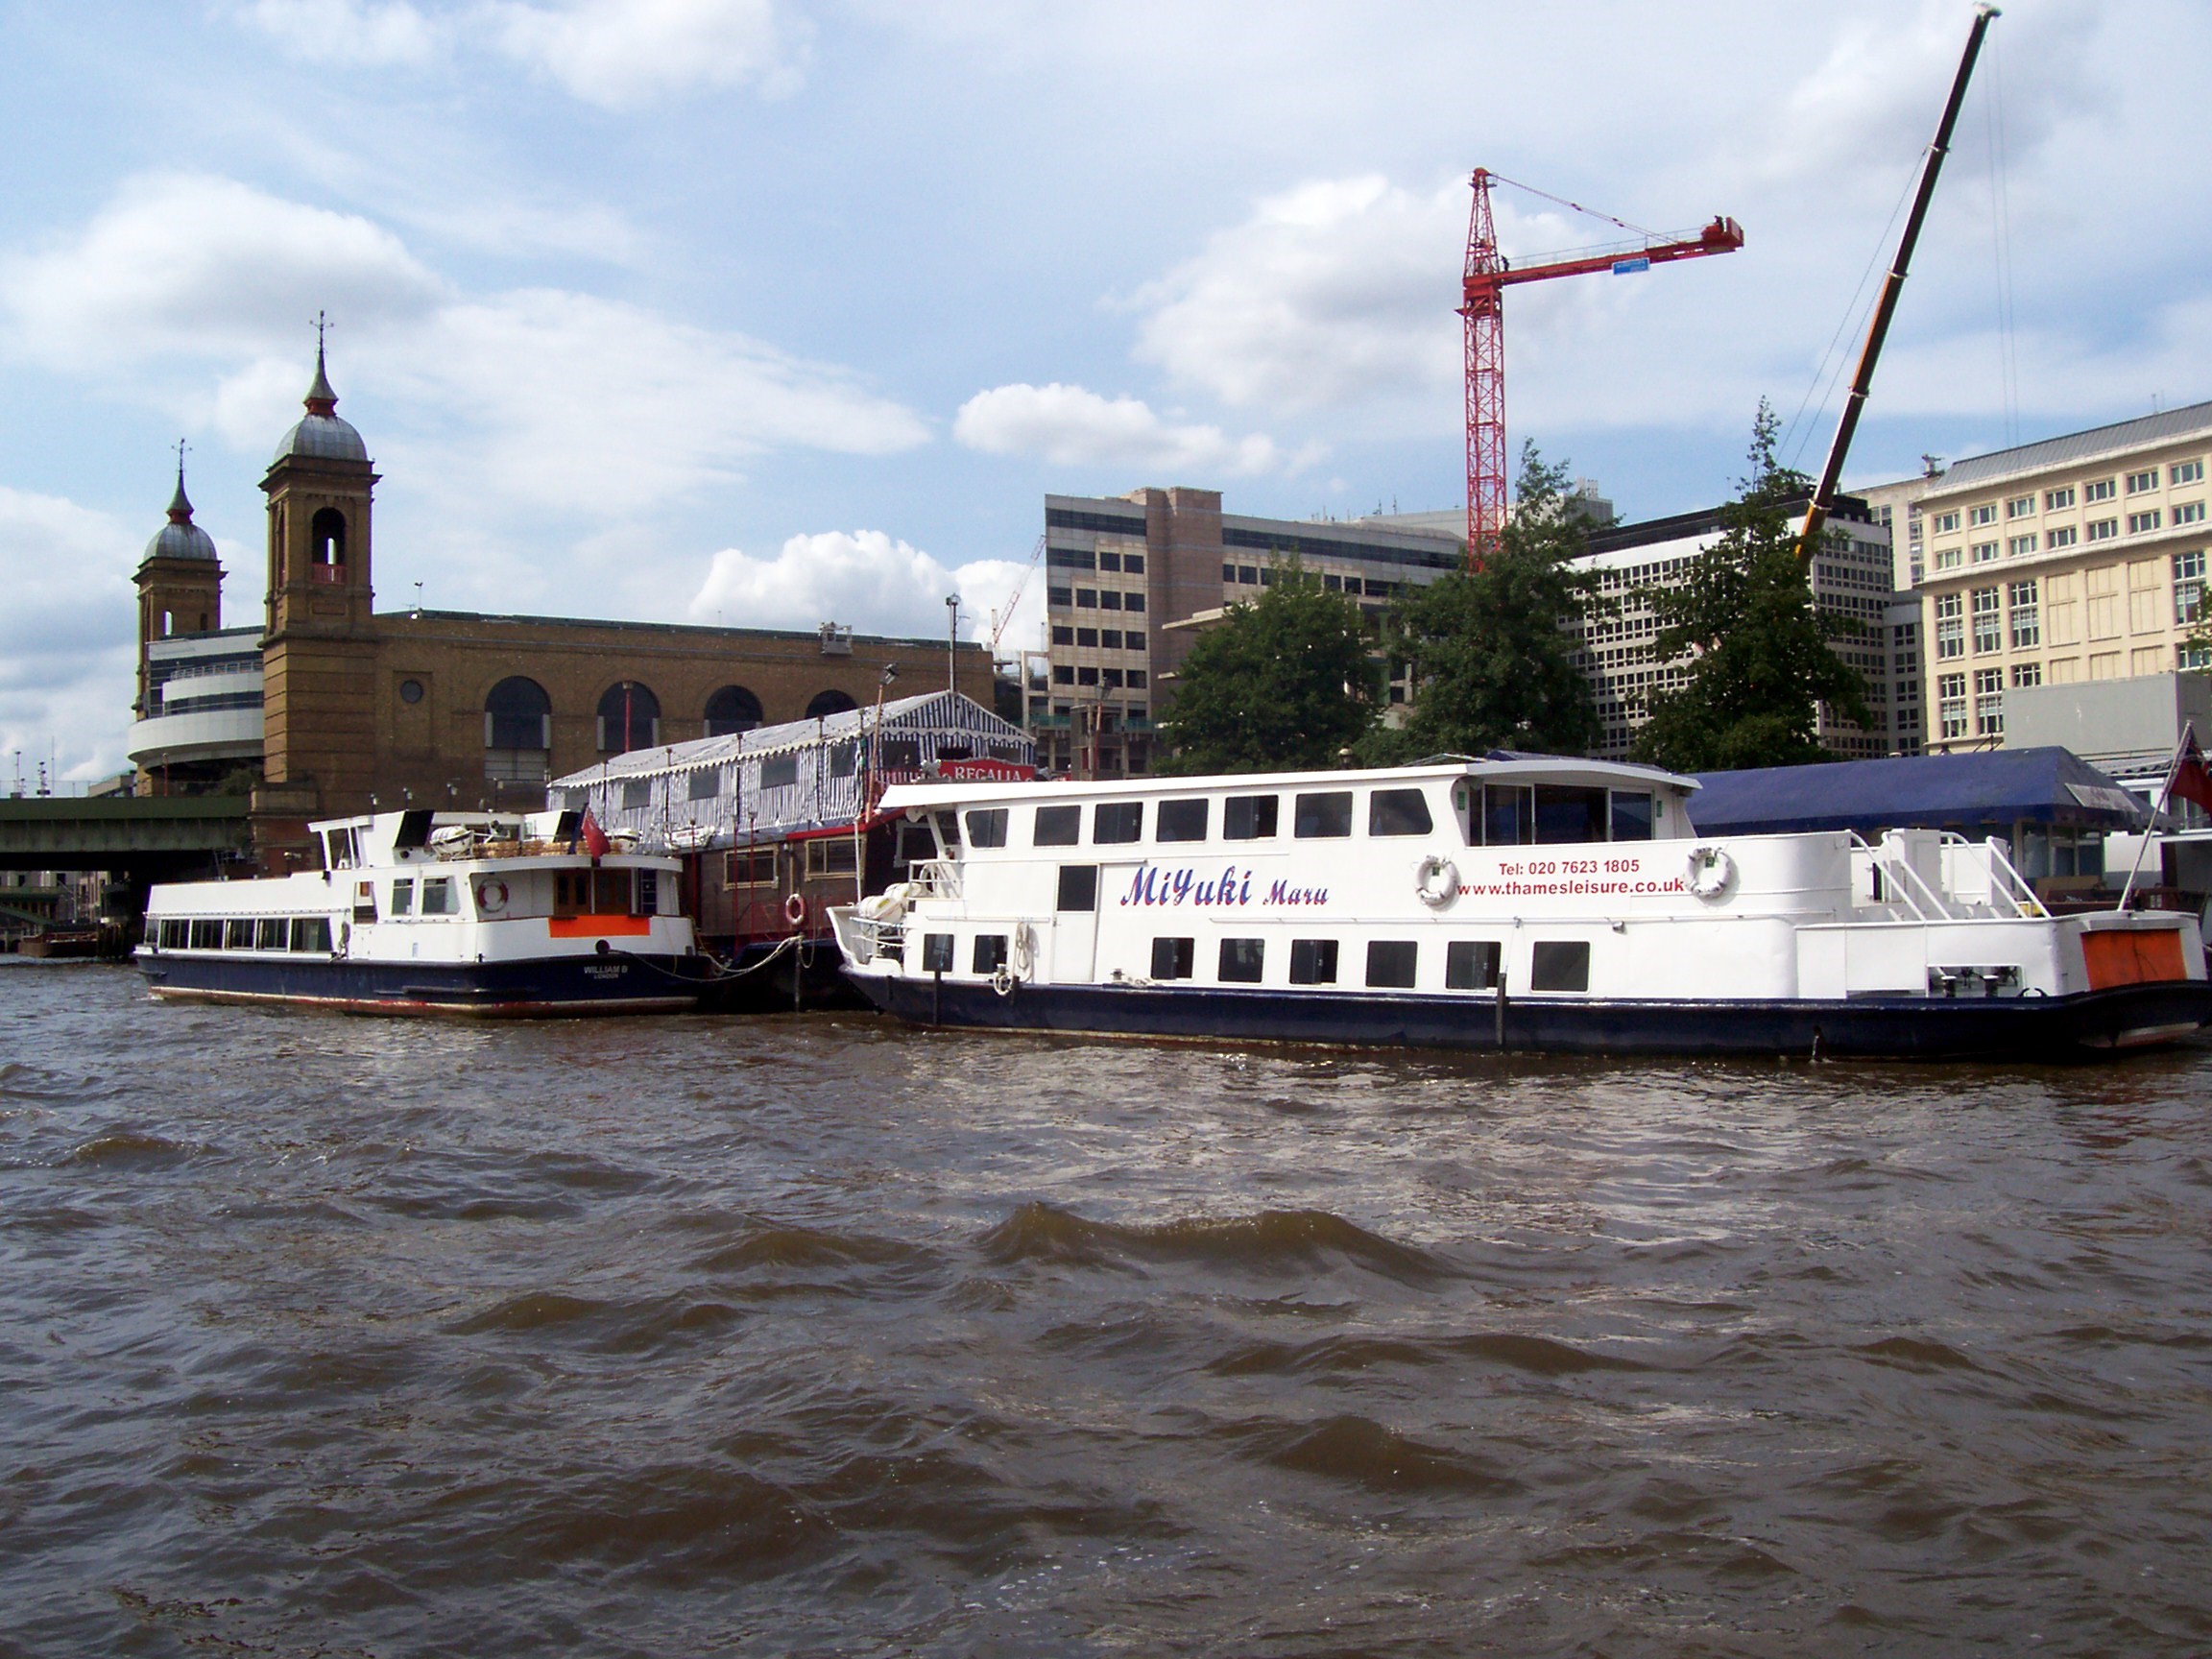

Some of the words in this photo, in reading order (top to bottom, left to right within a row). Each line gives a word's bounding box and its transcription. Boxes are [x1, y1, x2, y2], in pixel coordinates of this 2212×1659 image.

[954, 766, 1021, 781] REGALIA
[1499, 863, 1524, 876] Tel:
[1528, 861, 1556, 875] 020
[1561, 860, 1598, 874] 7623
[1603, 859, 1640, 873] 1805
[1262, 878, 1329, 905] Maru
[1457, 878, 1684, 895] www.thamesleisure.co.uk
[584, 965, 620, 974] WILLIAM
